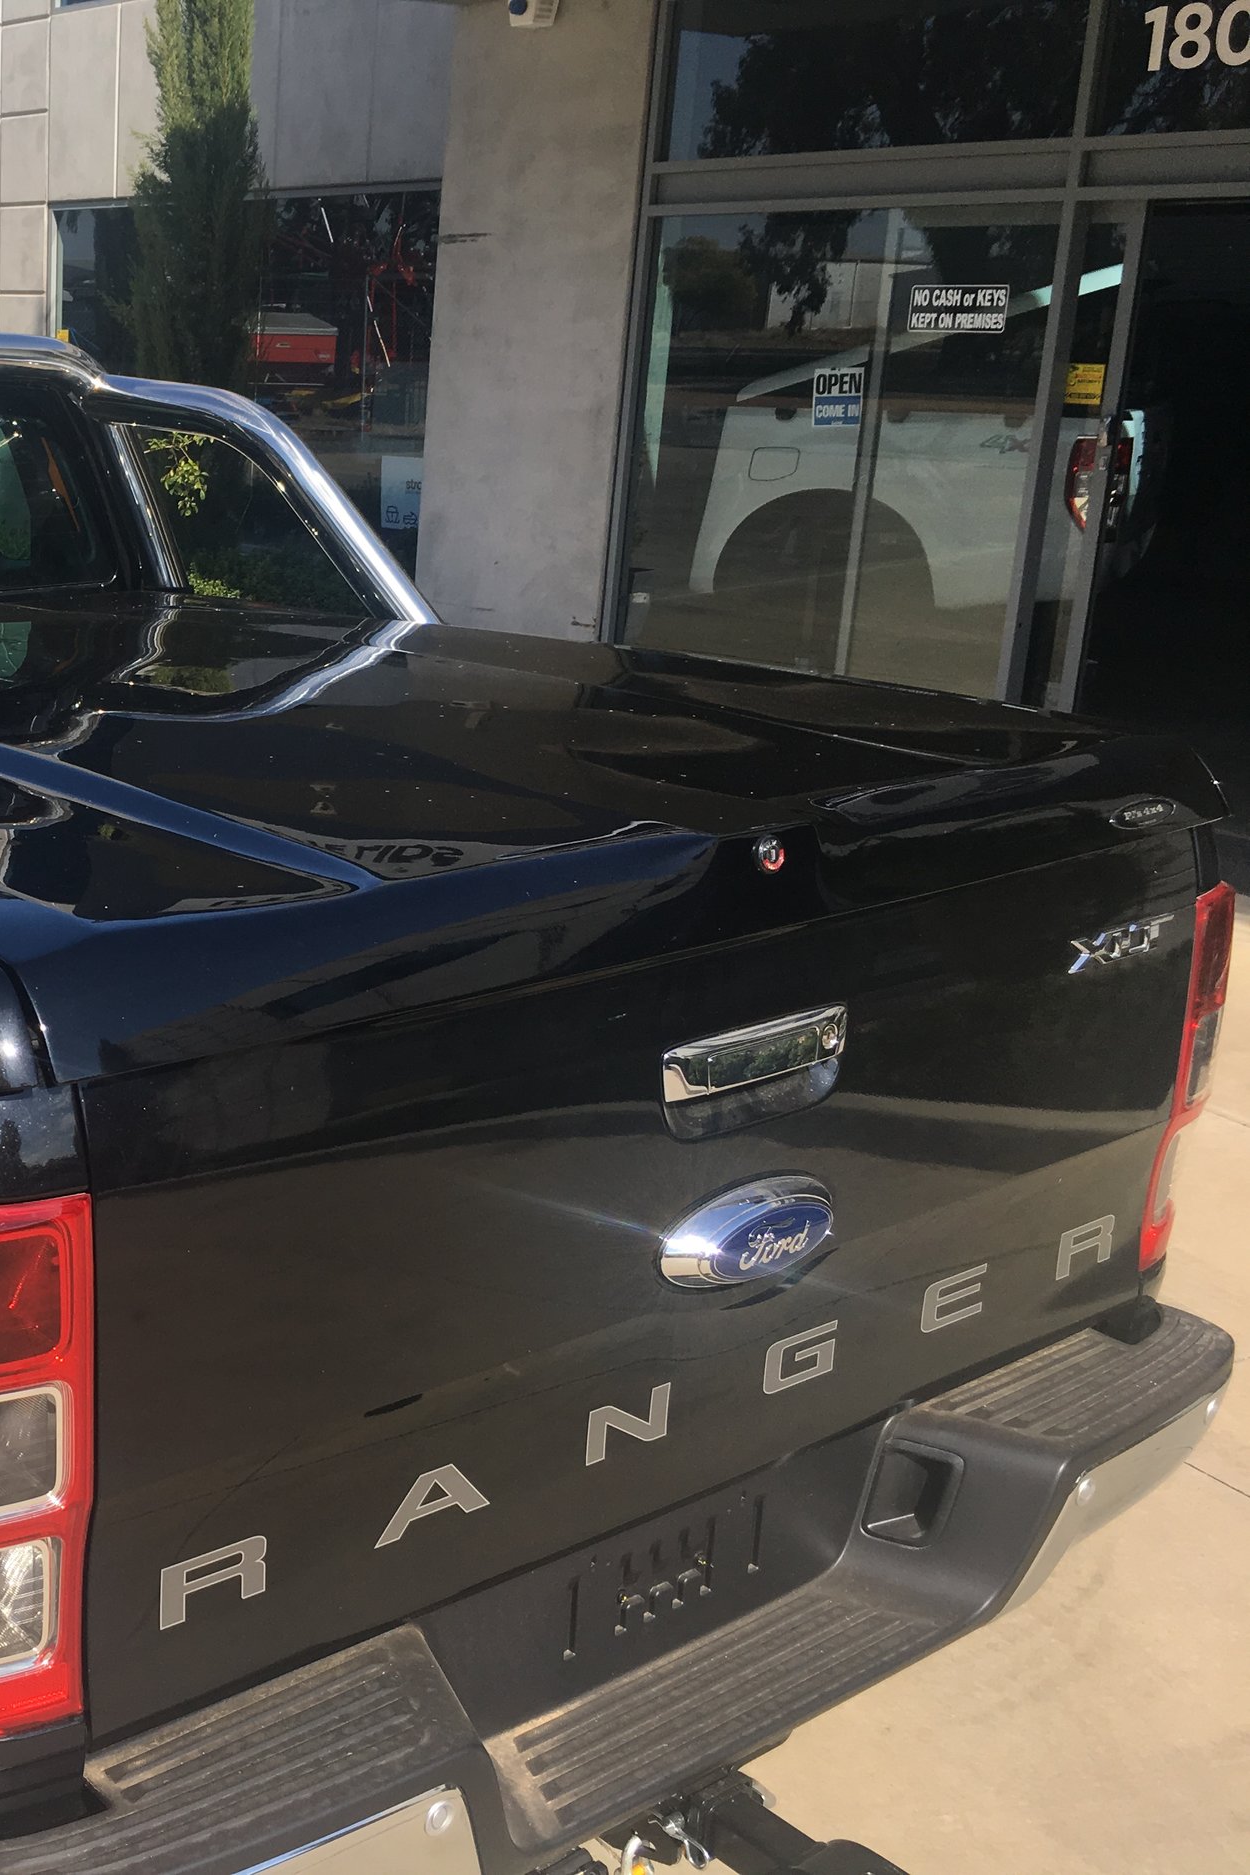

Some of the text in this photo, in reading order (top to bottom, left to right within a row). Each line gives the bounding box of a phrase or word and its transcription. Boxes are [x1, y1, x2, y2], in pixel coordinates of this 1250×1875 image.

[1144, 0, 1250, 72] 180
[913, 289, 1006, 306] NO CASH or KEYS
[911, 312, 1004, 329] KEPT ON PREMISES
[815, 372, 862, 395] OPEN
[815, 404, 860, 418] COME IN
[1068, 912, 1175, 975] XLT
[739, 1219, 809, 1271] Ford
[159, 1213, 1116, 1631] RANGER
